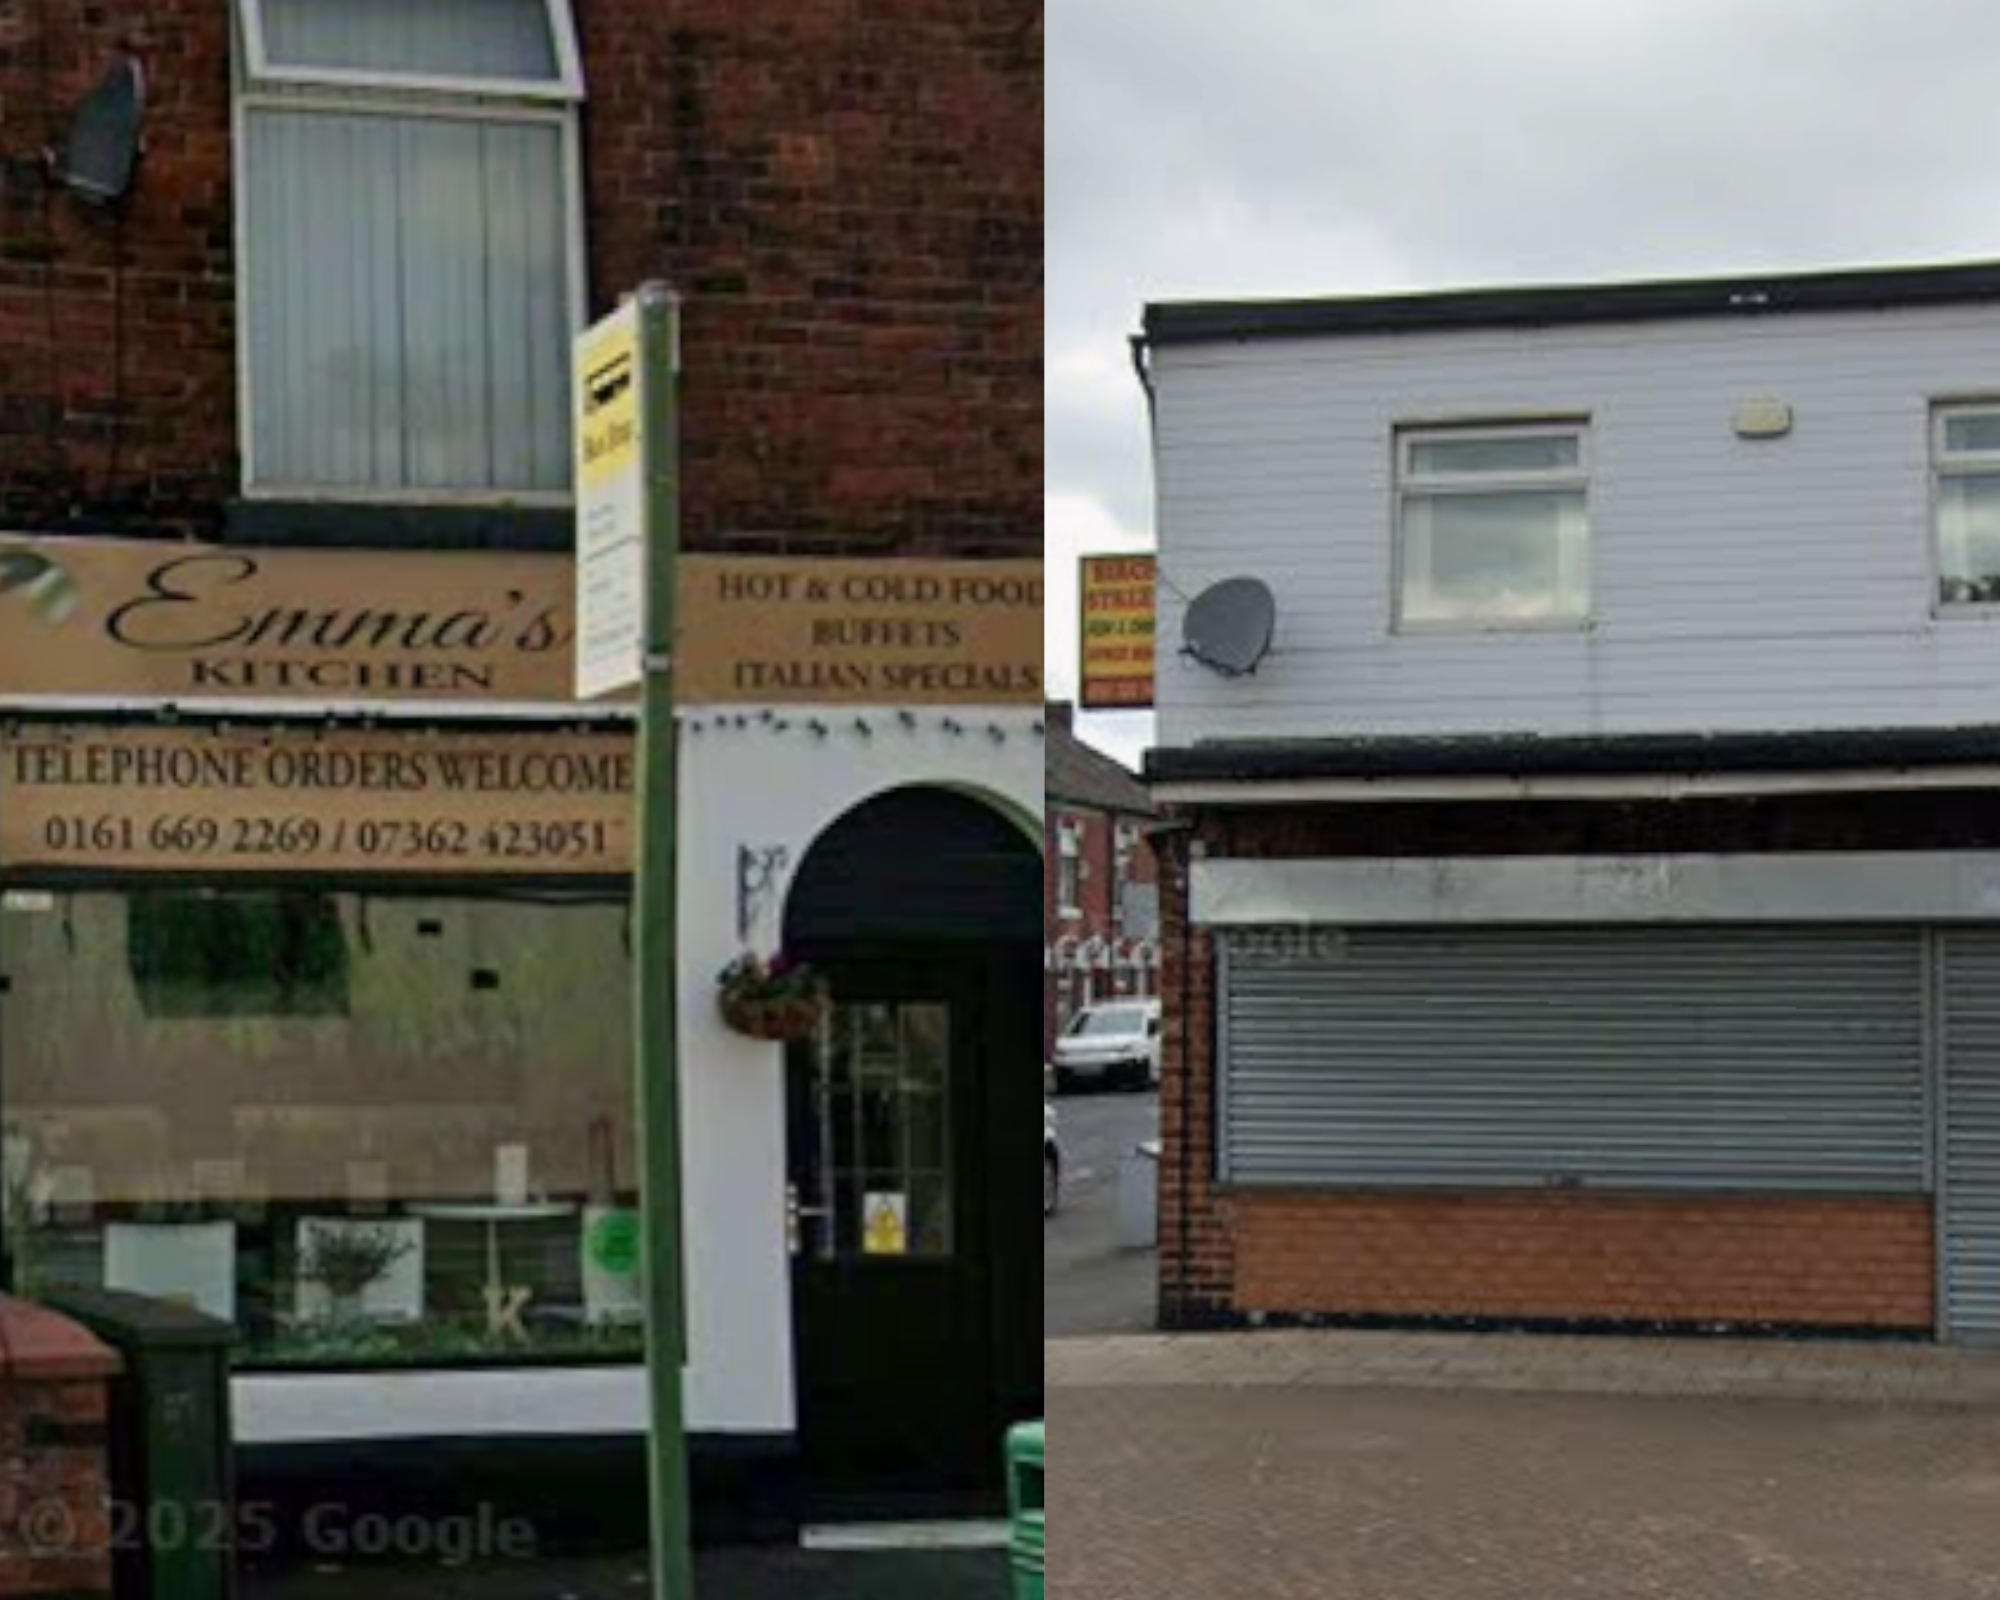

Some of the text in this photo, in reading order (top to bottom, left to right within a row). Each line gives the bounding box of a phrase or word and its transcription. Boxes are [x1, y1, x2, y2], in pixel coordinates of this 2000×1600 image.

[107, 554, 574, 651] Emma's
[718, 572, 797, 601] HOT
[805, 576, 828, 601] &
[841, 575, 941, 603] COLD
[812, 618, 961, 646] BUFFETS
[191, 659, 493, 690] KITCHEN
[734, 661, 1040, 692] ITALIAN SPECIALS
[10, 743, 634, 794] TELEPHONE ORDERS WELCOME
[45, 816, 605, 857] 0161 669 2269 / 07362 423051
